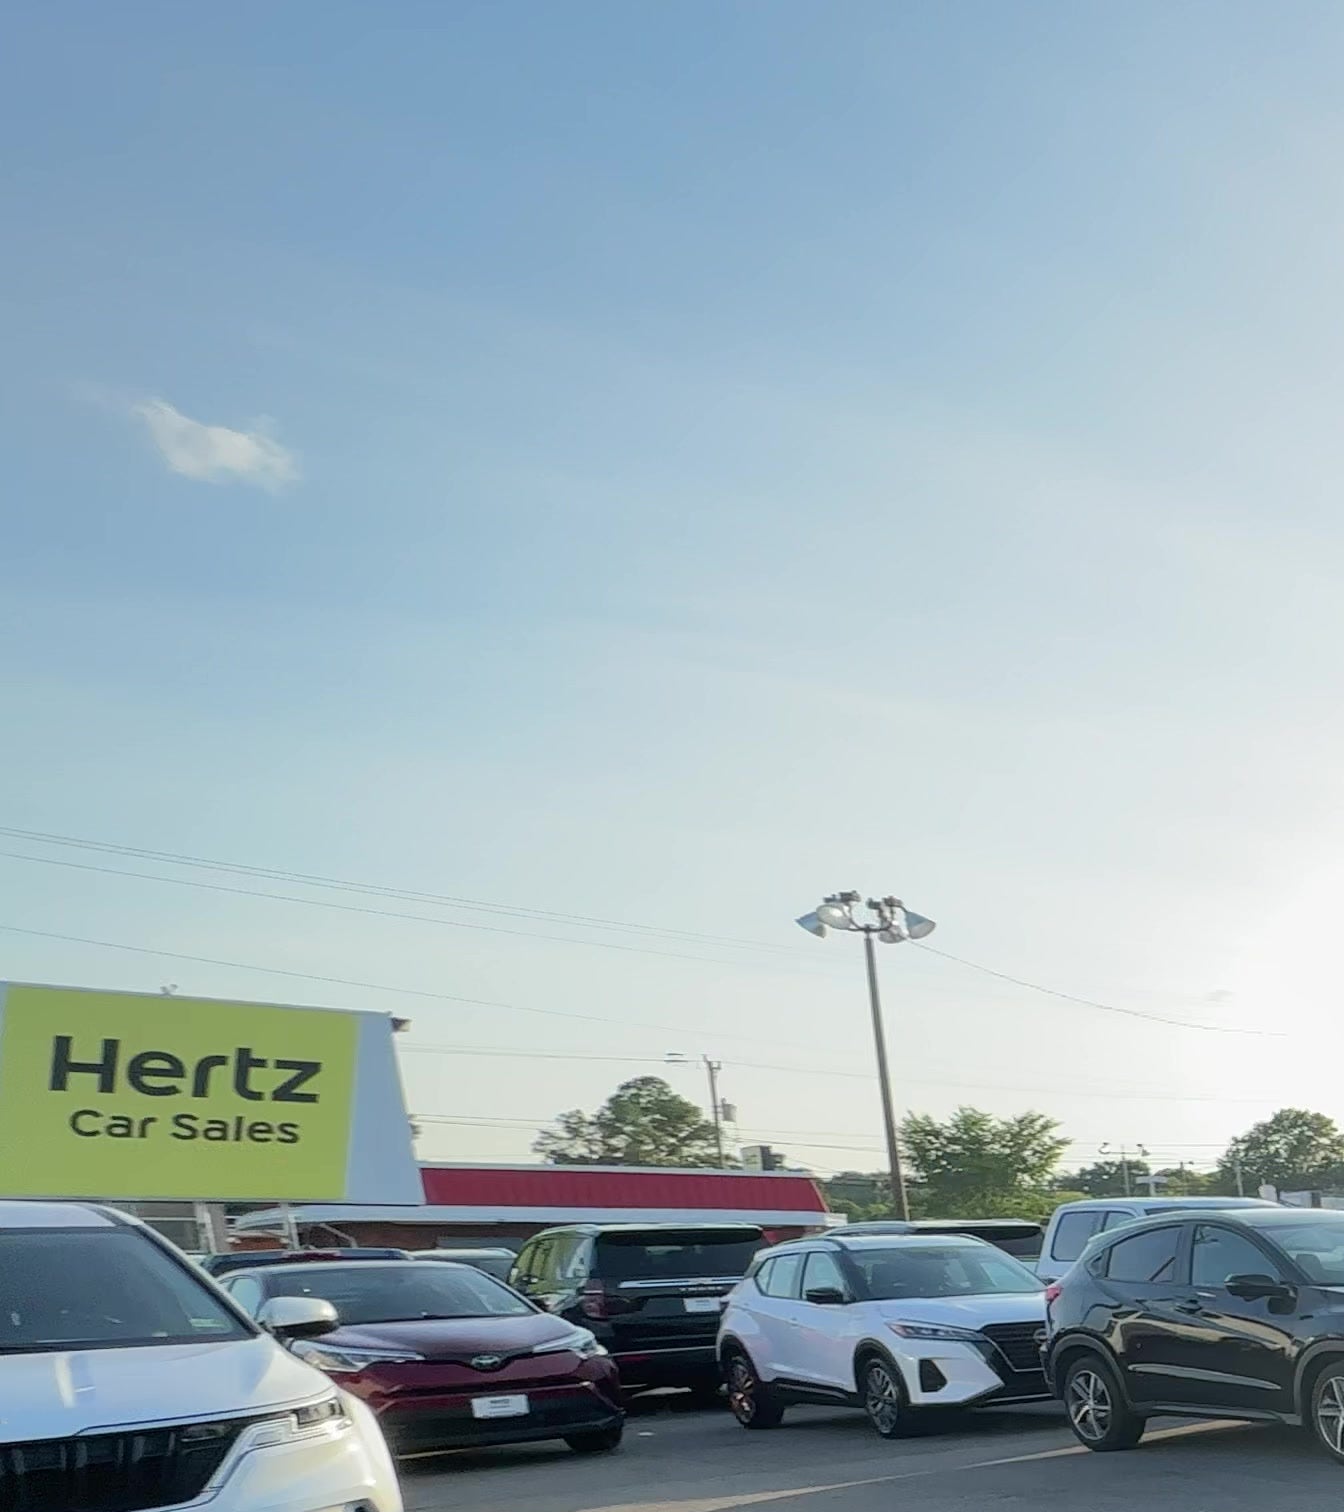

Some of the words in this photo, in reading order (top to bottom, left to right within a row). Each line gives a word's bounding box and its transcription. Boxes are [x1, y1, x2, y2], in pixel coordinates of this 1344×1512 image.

[48, 1034, 322, 1103] Hertz
[69, 1109, 158, 1139] Car
[171, 1113, 301, 1144] Sales
